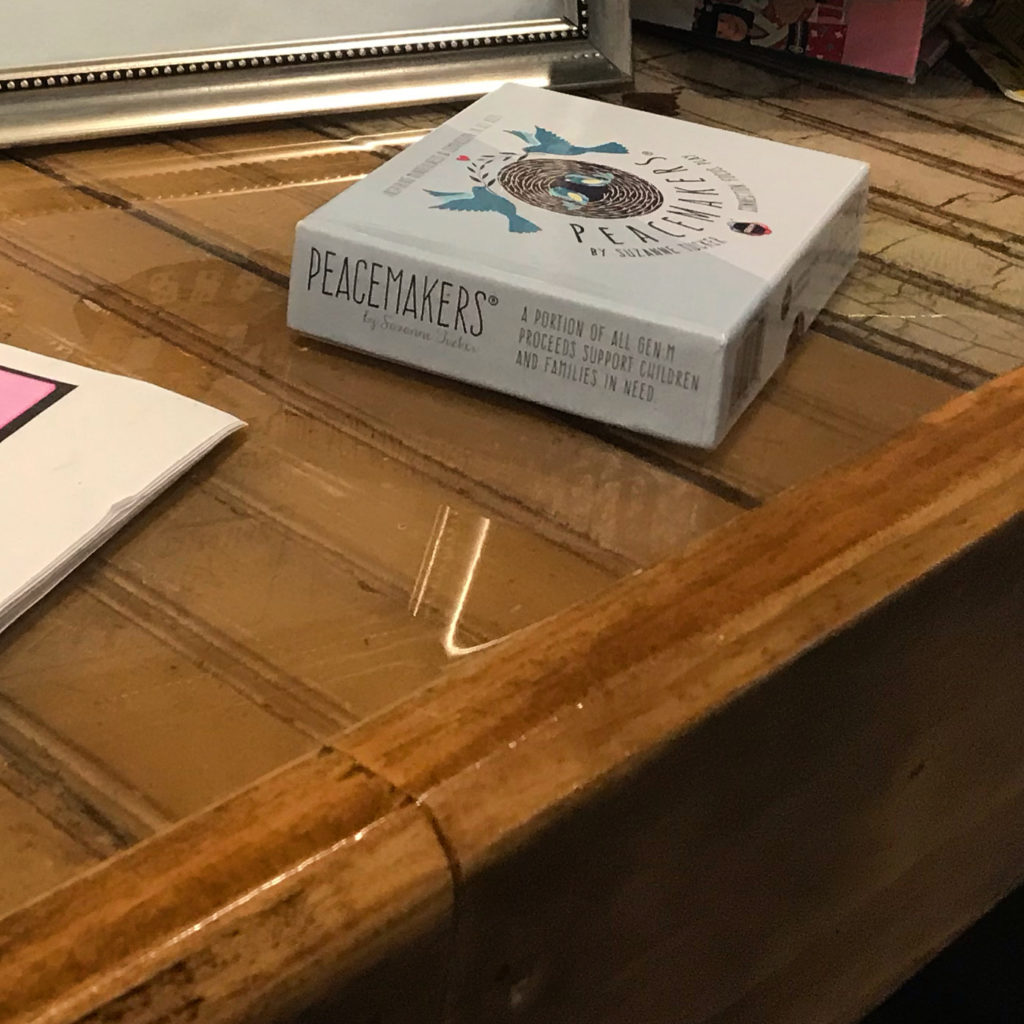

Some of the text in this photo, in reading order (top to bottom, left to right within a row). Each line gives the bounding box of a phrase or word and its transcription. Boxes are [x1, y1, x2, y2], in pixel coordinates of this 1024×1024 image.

[590, 246, 607, 258] BY
[617, 244, 681, 259] SUZANNE
[520, 305, 528, 323] A
[534, 308, 584, 338] PORTION
[589, 323, 606, 343] OF
[610, 330, 631, 351] ALL
[515, 350, 655, 403] AND FAMILIES IN NEED
[518, 326, 701, 392] PROCEEDS SUPPORT CHILDREN
